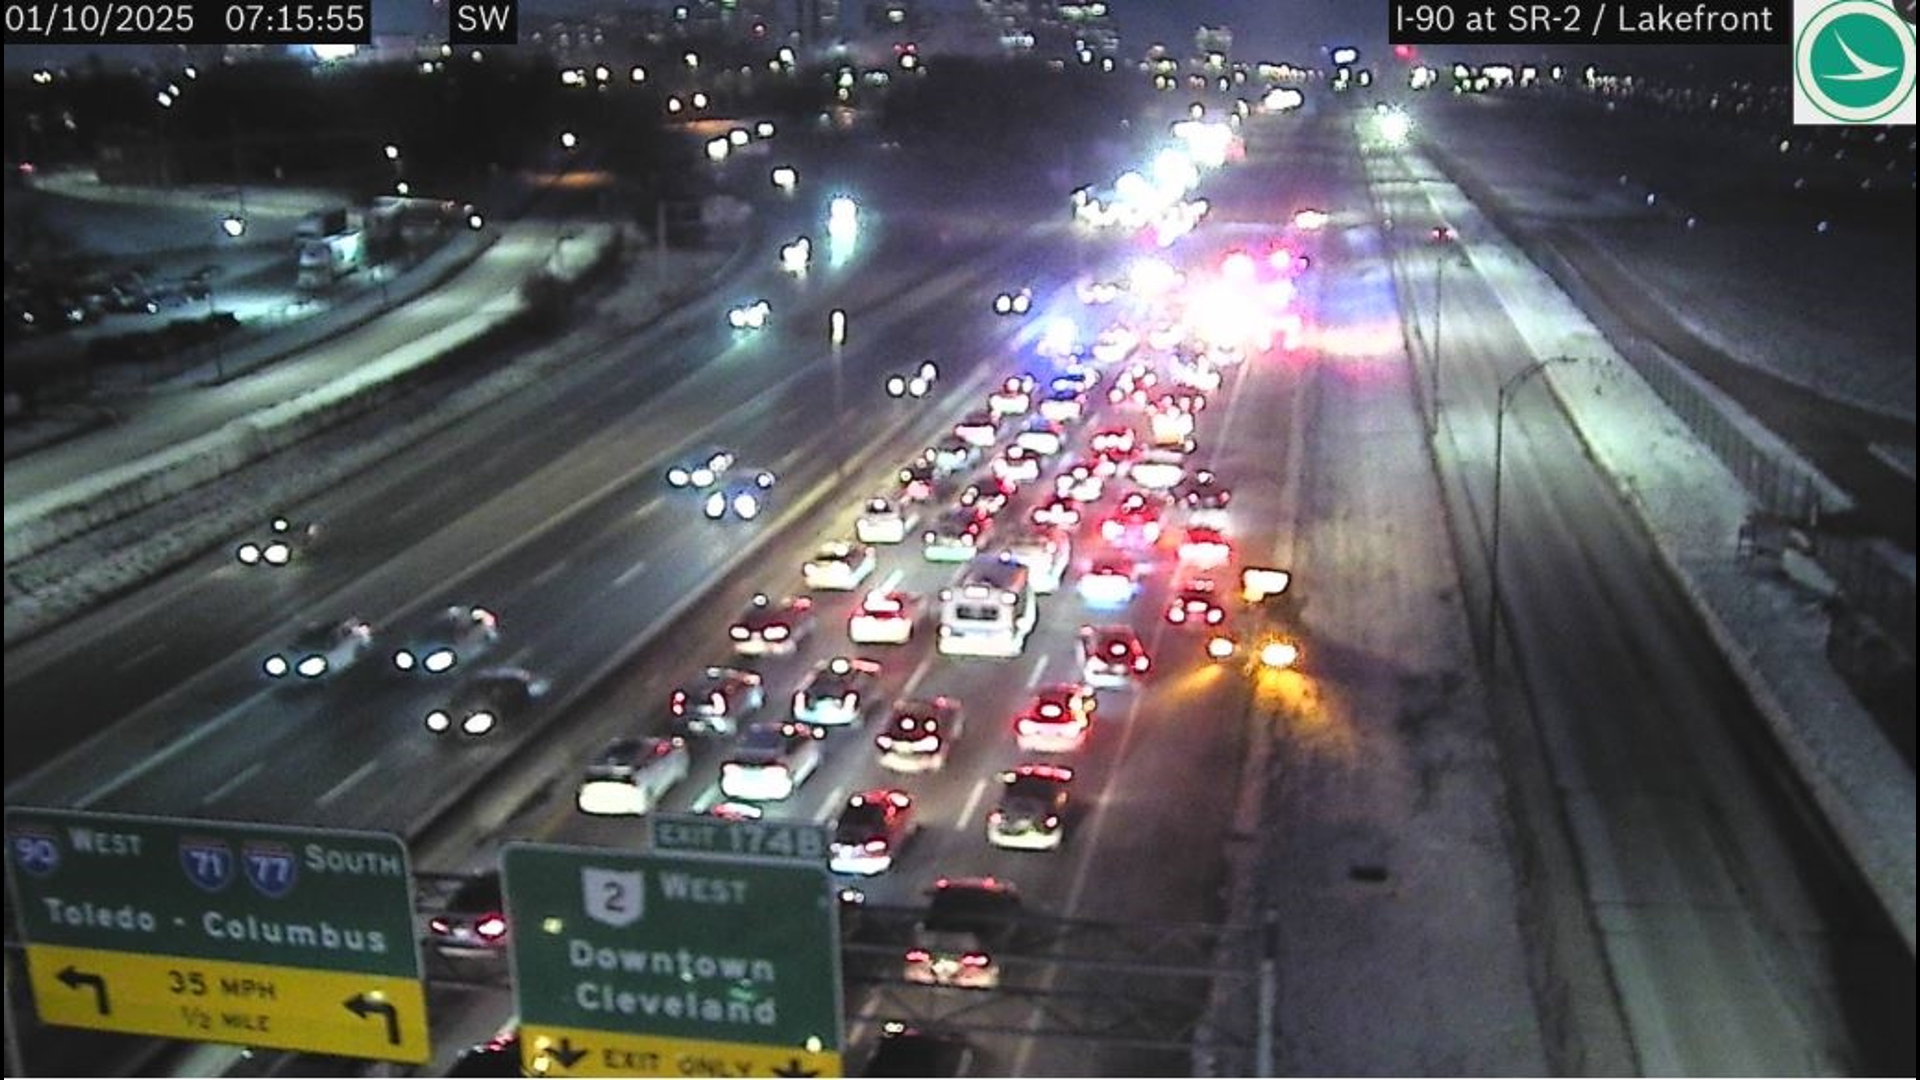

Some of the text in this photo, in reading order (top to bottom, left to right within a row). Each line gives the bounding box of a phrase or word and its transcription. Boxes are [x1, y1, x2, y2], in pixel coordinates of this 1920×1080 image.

[15, 828, 400, 883] 90 WEST 71 77 SOUTH
[602, 871, 748, 913] 2 WEST
[43, 897, 157, 933] Toledo
[203, 911, 388, 954] Columbus
[569, 939, 776, 983] Downtown
[168, 970, 278, 1001] 35 MPH
[576, 981, 777, 1025] Cleveland
[221, 1012, 271, 1033] MILE
[603, 1049, 753, 1077] EXIT ONLY
